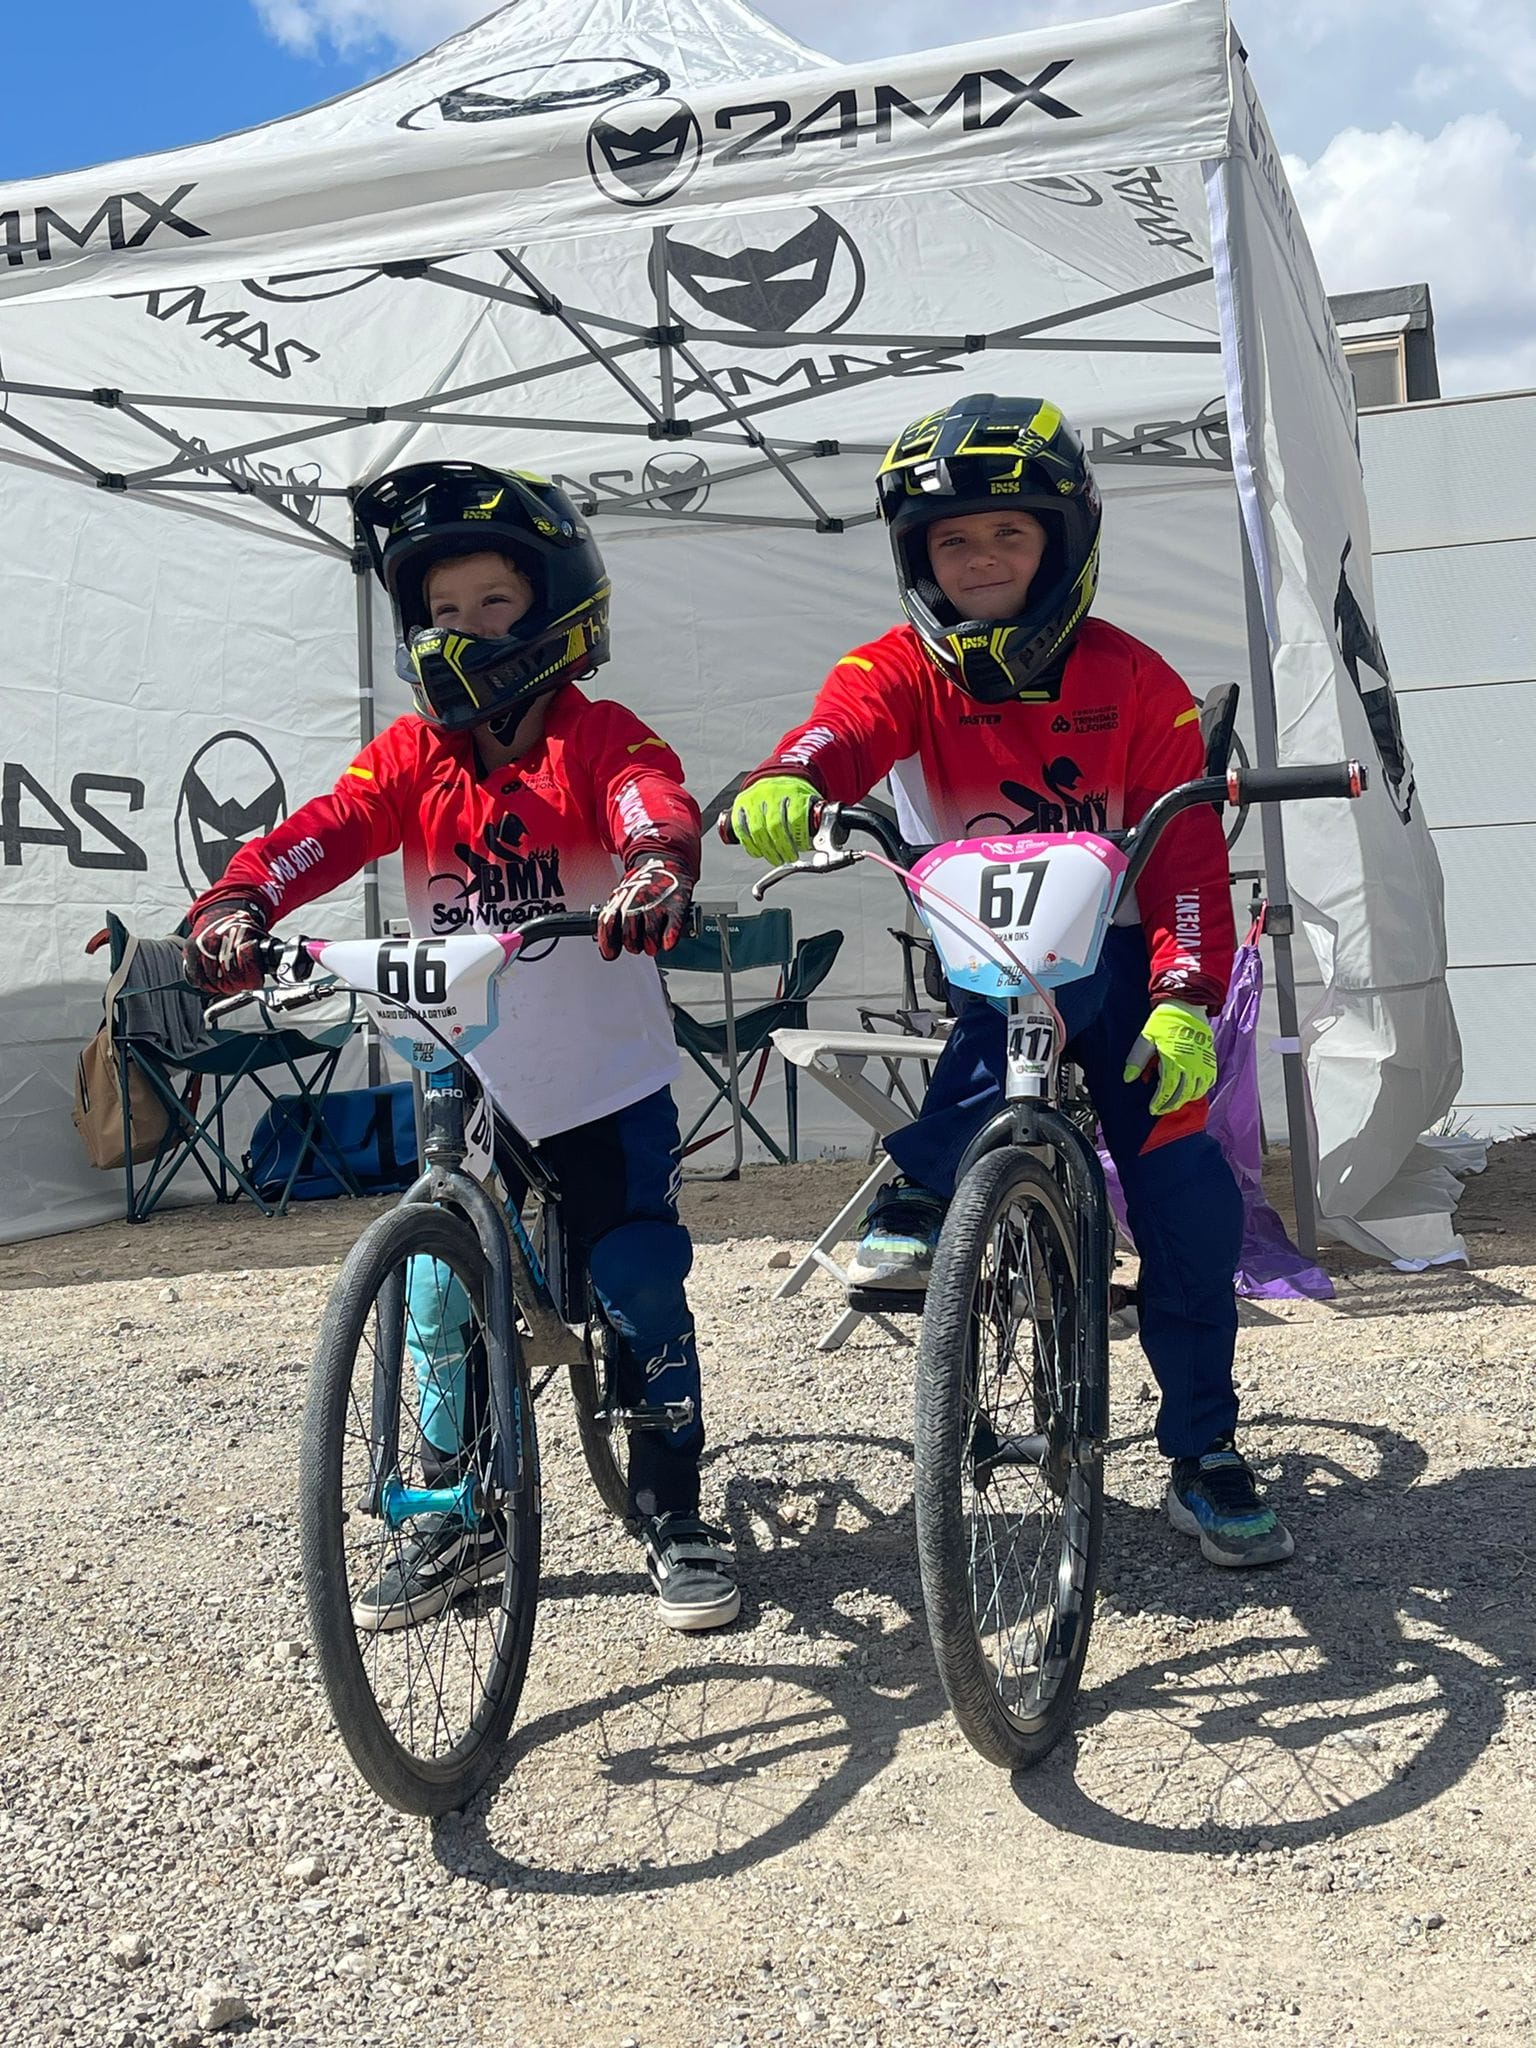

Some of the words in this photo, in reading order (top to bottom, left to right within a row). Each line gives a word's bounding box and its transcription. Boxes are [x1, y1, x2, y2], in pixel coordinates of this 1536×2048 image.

[714, 59, 1082, 167] 24MX
[481, 859, 565, 903] BMX
[979, 860, 1050, 928] 67
[1174, 887, 1201, 949] VICENT
[377, 939, 447, 1005] 66
[1009, 1027, 1052, 1061] 417
[424, 1088, 463, 1099] HARO
